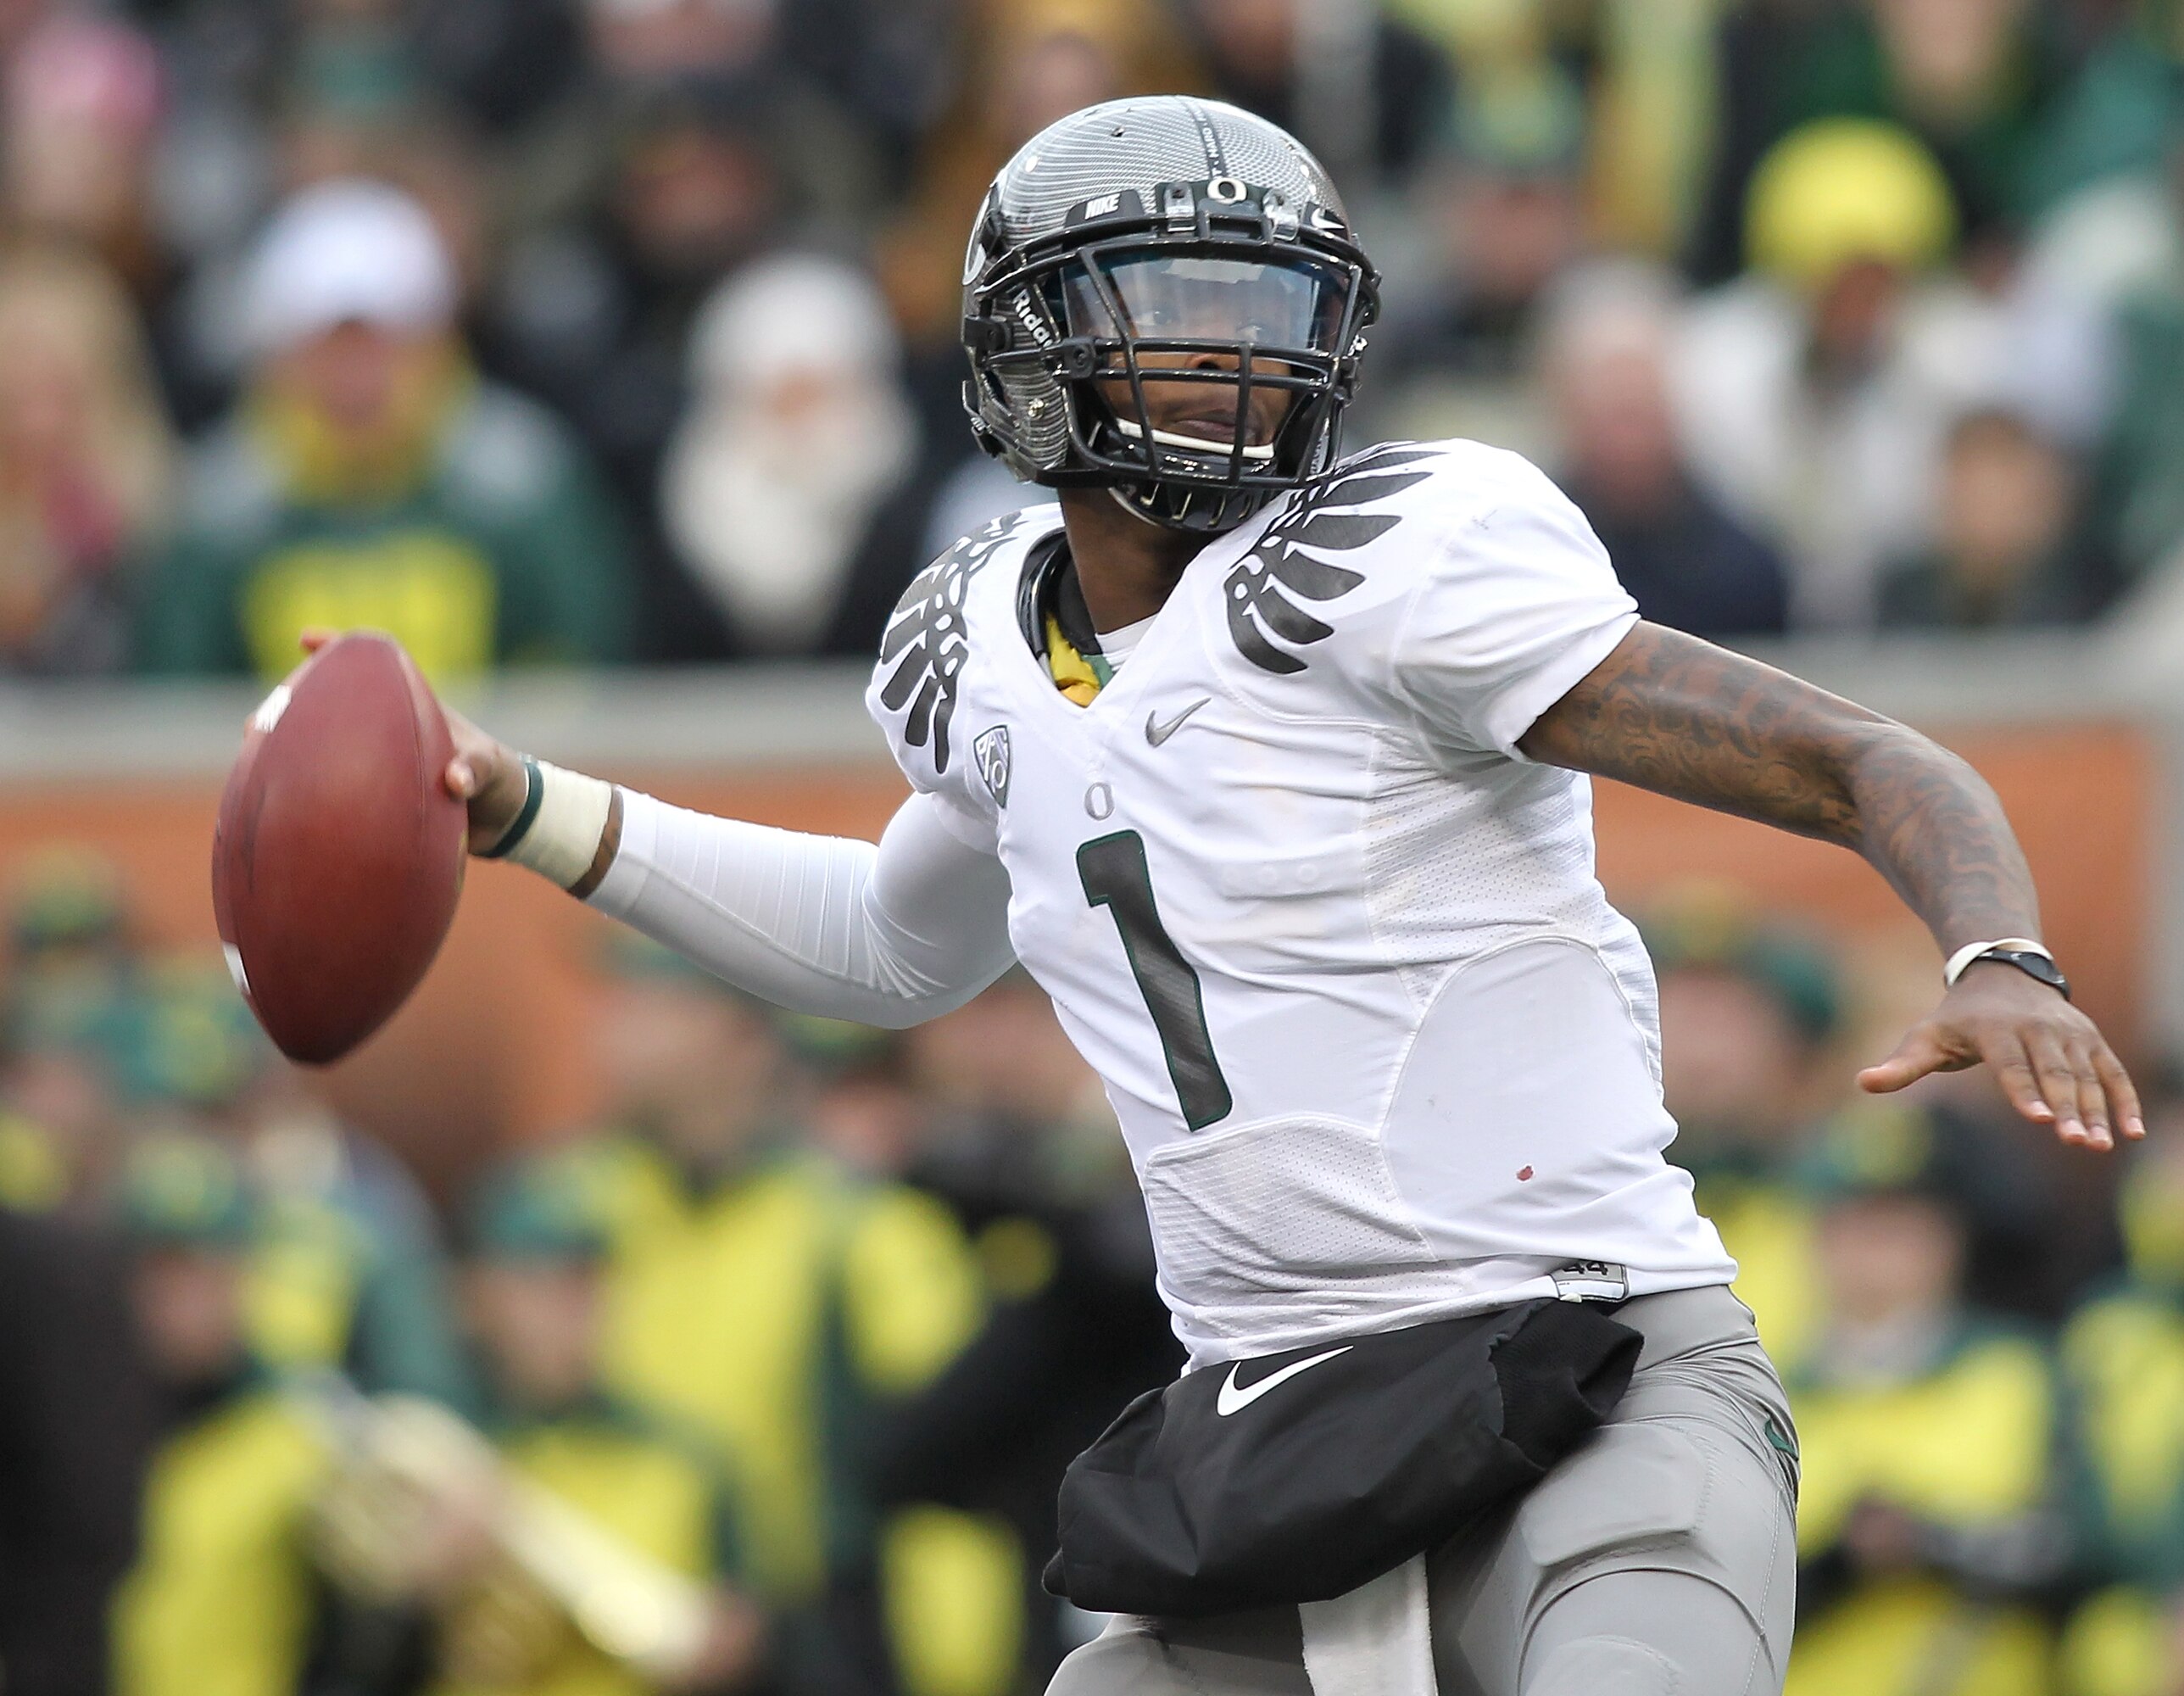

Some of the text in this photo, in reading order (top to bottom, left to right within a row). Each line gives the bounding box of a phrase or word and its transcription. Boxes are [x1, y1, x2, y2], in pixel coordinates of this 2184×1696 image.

[1084, 193, 1121, 220] NIKE
[1011, 288, 1053, 348] Ridd
[1076, 828, 1234, 1133] 1
